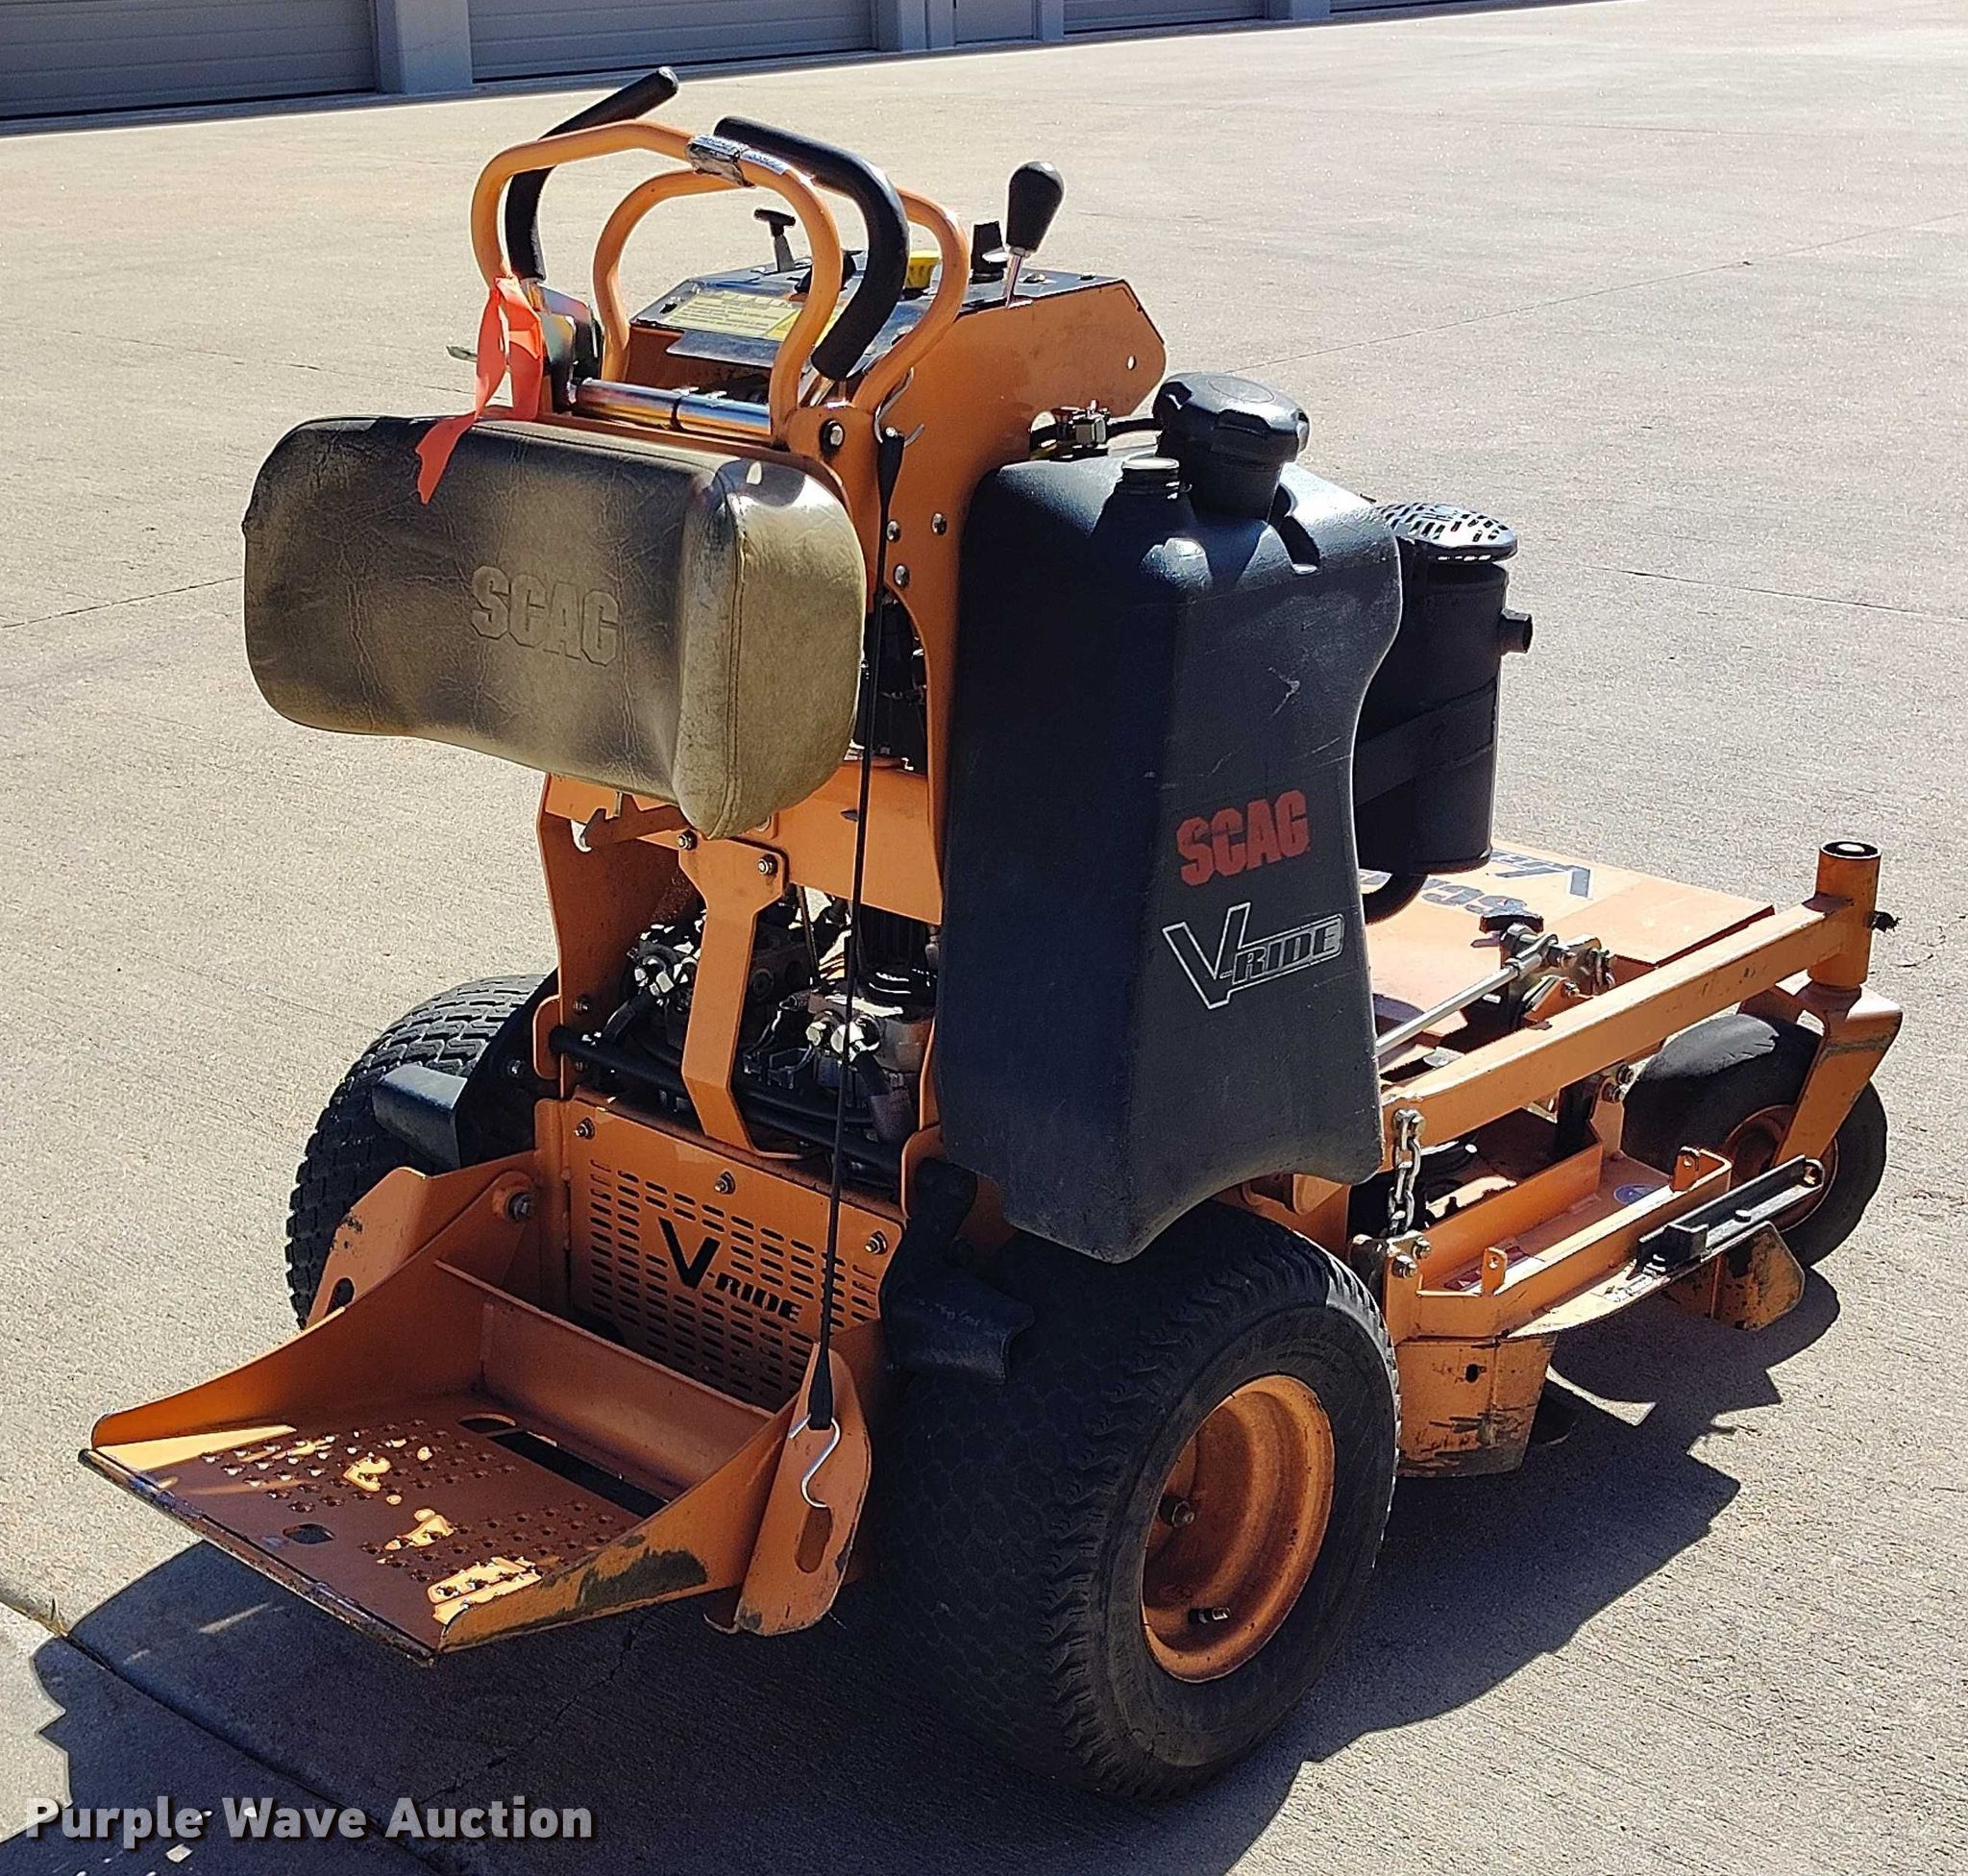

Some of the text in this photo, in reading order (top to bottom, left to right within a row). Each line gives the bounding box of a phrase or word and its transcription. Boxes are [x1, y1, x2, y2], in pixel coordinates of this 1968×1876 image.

[472, 565, 621, 666] SCAG
[1176, 790, 1310, 886] SCAG
[1163, 902, 1344, 1009] V-RIDE
[658, 1217, 803, 1323] V-RIDE
